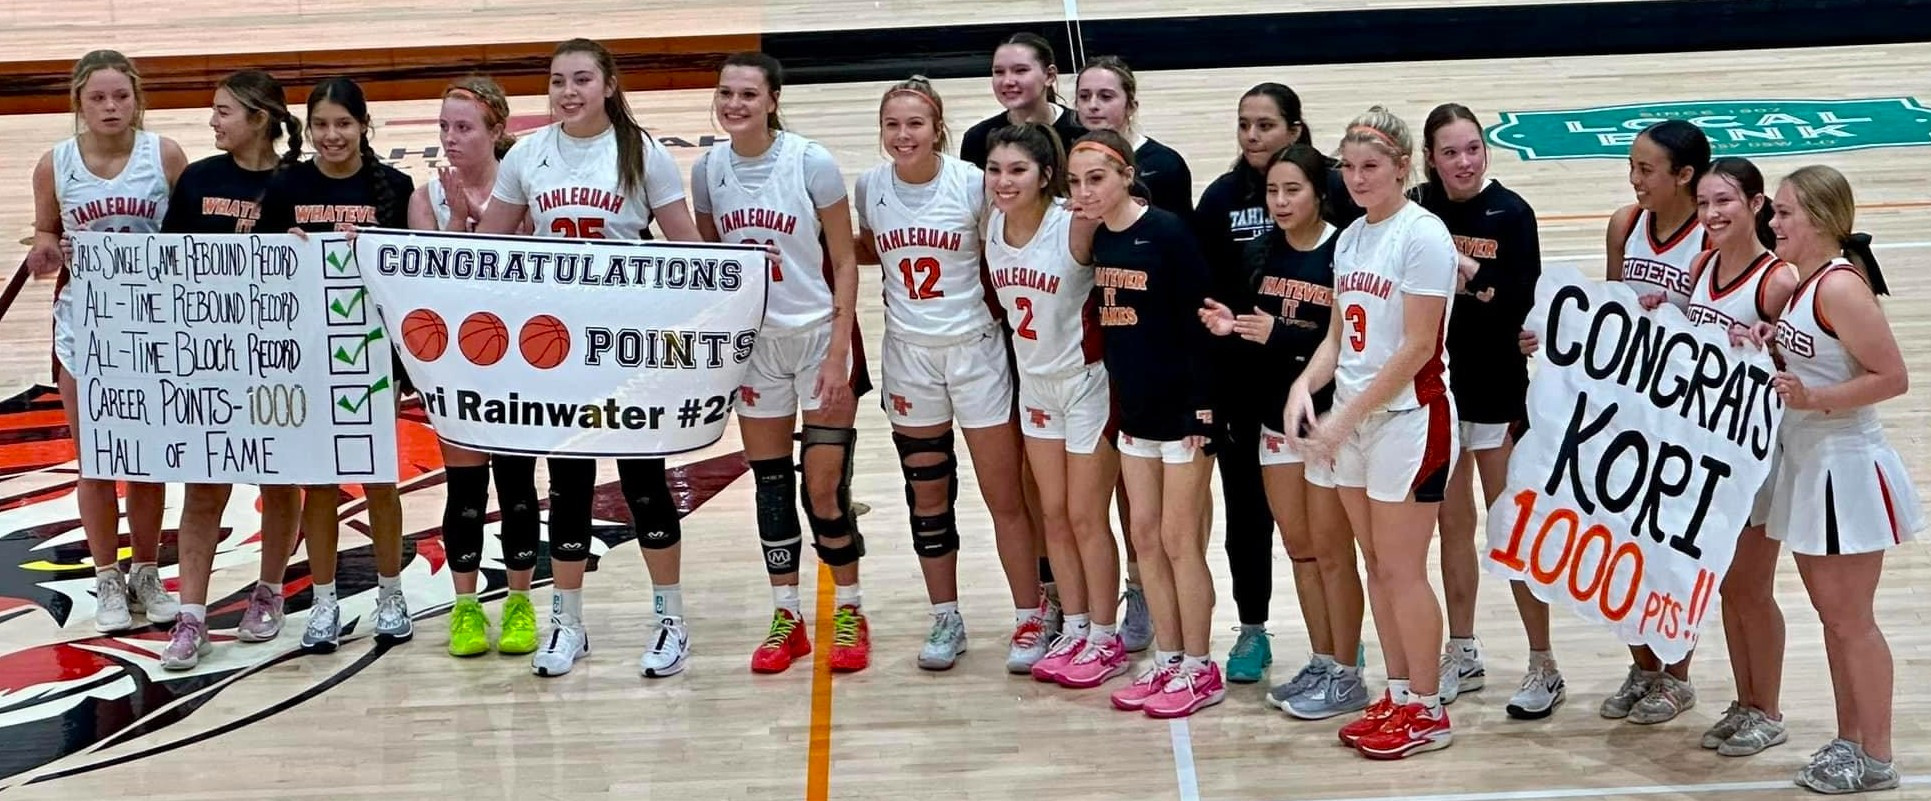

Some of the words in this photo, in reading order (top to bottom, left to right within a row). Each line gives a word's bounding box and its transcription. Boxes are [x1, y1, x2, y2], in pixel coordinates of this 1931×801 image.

[1596, 124, 1858, 146] BNK
[69, 197, 158, 225] TAHLEQUAH
[535, 187, 625, 214] TAHLEQUAH
[720, 208, 797, 235] TAHLEQUAH
[146, 236, 183, 283] GAME
[183, 235, 247, 283] REBOUND
[249, 235, 298, 283] RECORD
[876, 227, 962, 253] TAHLEQUAH
[1452, 234, 1498, 259] EVER
[377, 244, 742, 292] CONGRATULATIONS
[899, 256, 945, 300] 12
[173, 283, 246, 328] REBOUND
[249, 283, 299, 330] RECORD
[1015, 296, 1038, 341] 2
[1345, 304, 1367, 352] 3
[176, 331, 239, 377] BLOCK
[248, 333, 300, 378] RECORD
[585, 326, 758, 370] POINTS
[1545, 284, 1782, 461] CONGRATS
[88, 377, 150, 427] CAREER
[457, 389, 665, 430] Rainwater
[94, 429, 151, 477] HALL
[166, 442, 188, 469] OF
[205, 431, 279, 478] FAME
[1545, 391, 1732, 560] KORI
[1489, 488, 1644, 622] 1000
